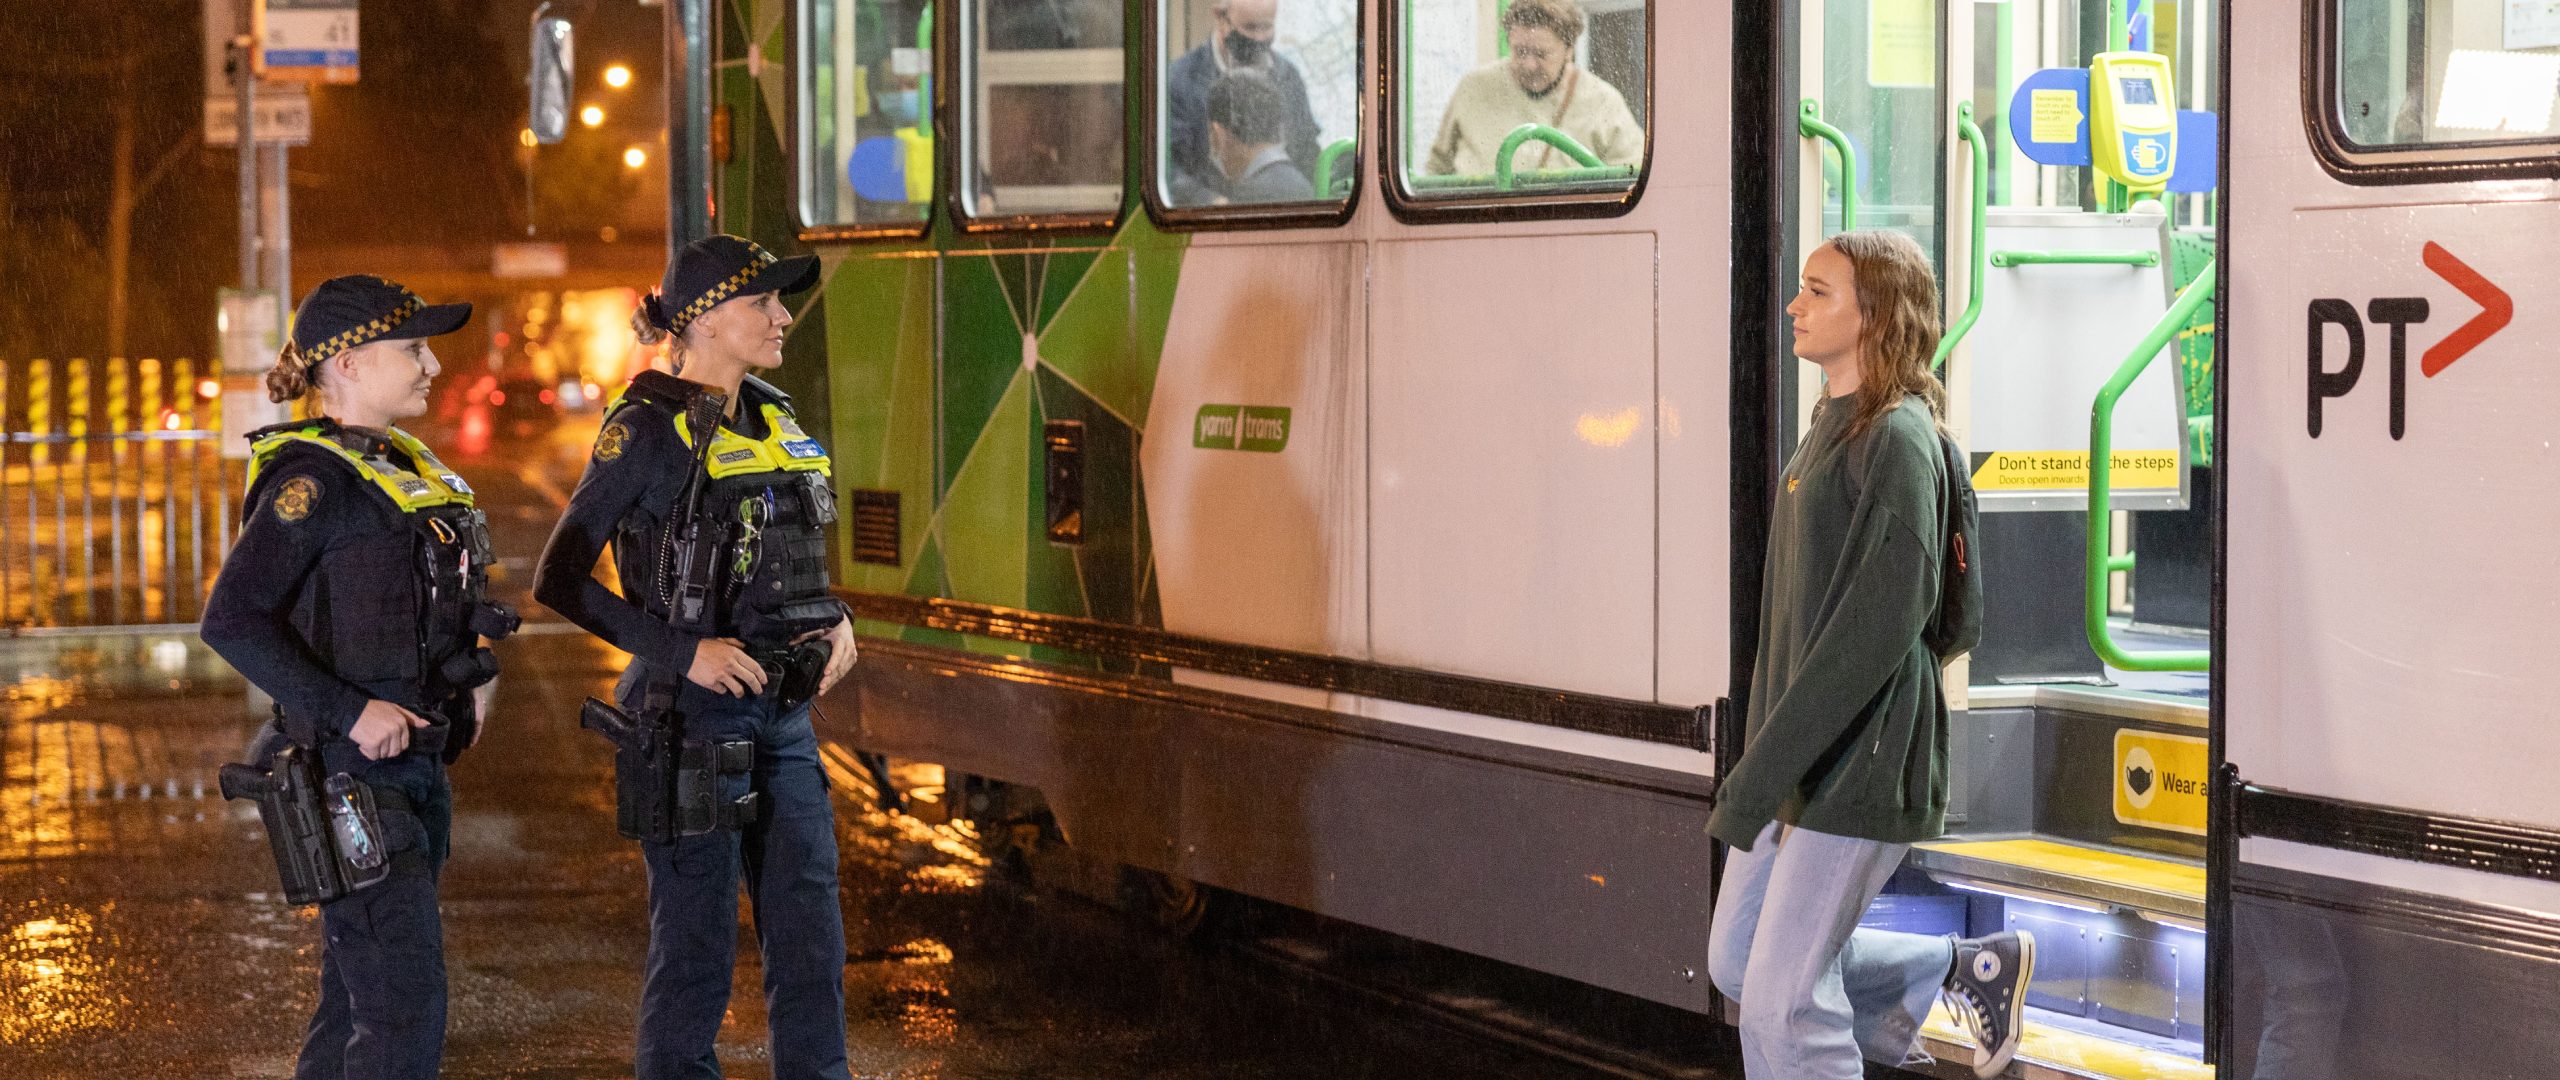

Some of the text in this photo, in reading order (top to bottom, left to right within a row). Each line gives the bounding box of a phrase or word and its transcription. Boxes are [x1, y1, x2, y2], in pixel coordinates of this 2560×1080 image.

[2307, 297, 2430, 441] PT
[1200, 412, 1283, 443] yarra trams
[1999, 455, 2037, 471] Don't
[2041, 455, 2082, 471] stand
[2135, 455, 2175, 473] steps
[1999, 473, 2085, 487] Doors open inwards
[2162, 771, 2197, 795] Wear
